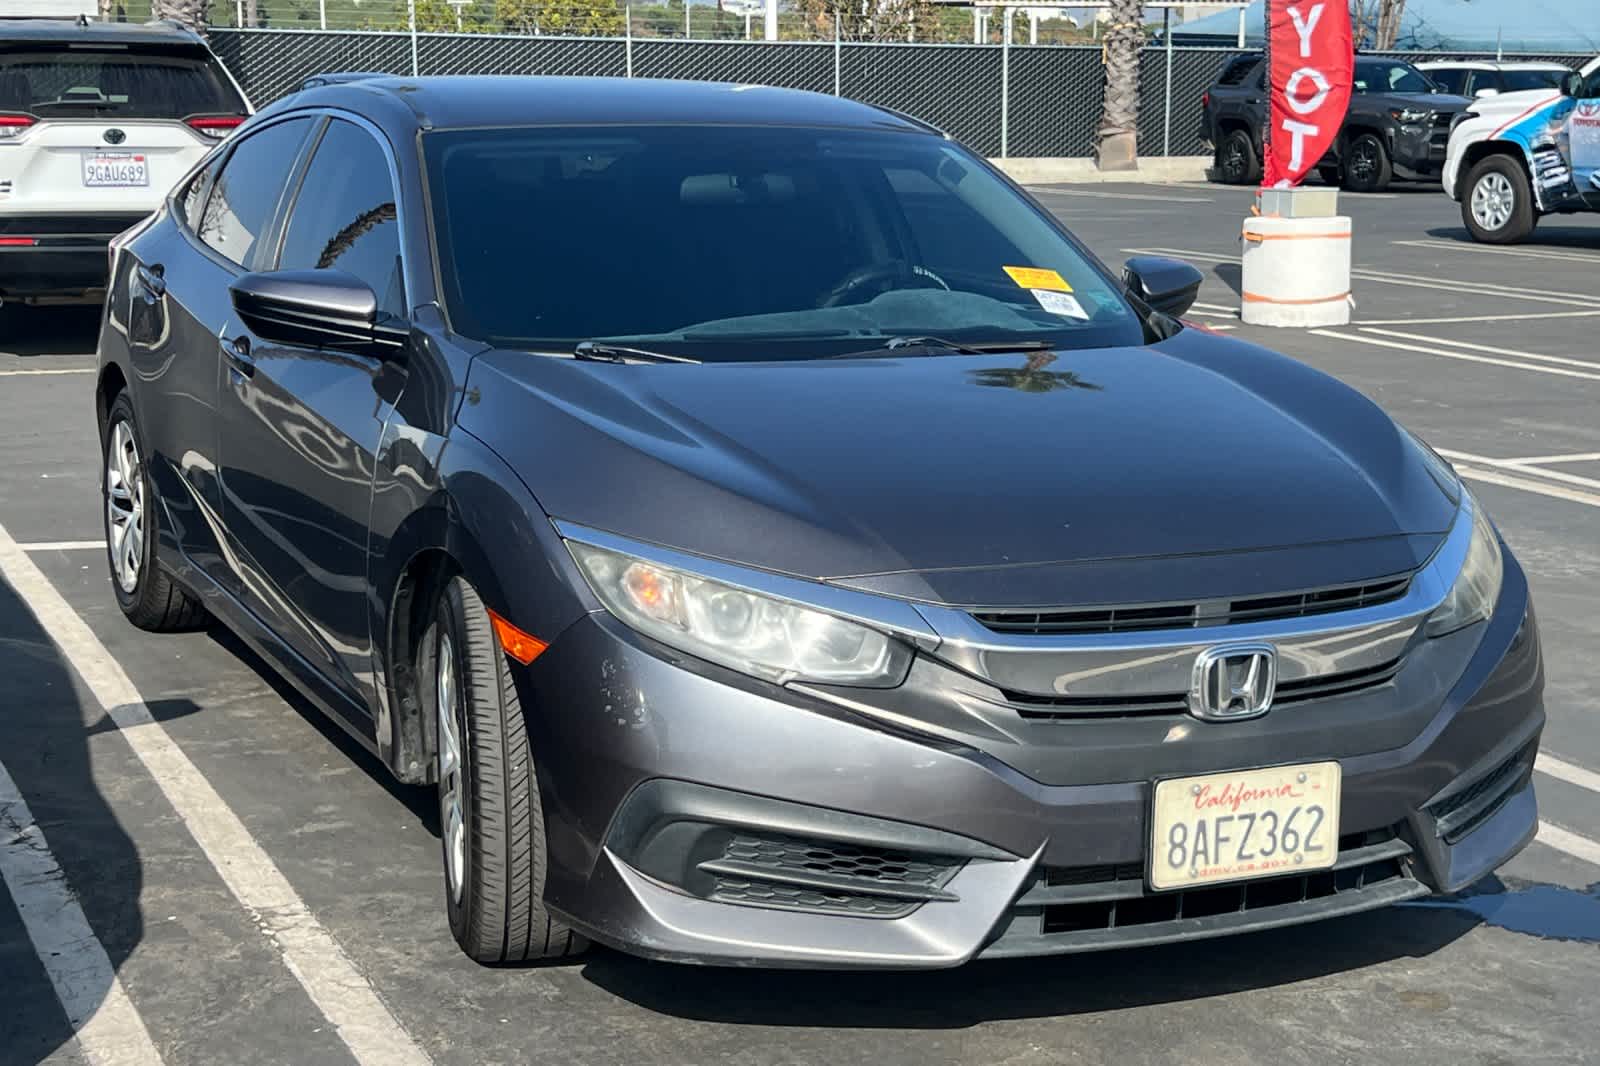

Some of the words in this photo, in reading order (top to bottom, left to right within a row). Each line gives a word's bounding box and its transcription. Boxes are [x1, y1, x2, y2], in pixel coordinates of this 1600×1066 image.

[87, 165, 144, 182] 9GAU689
[1194, 781, 1304, 812] California
[1167, 804, 1325, 870] 8AFZ362
